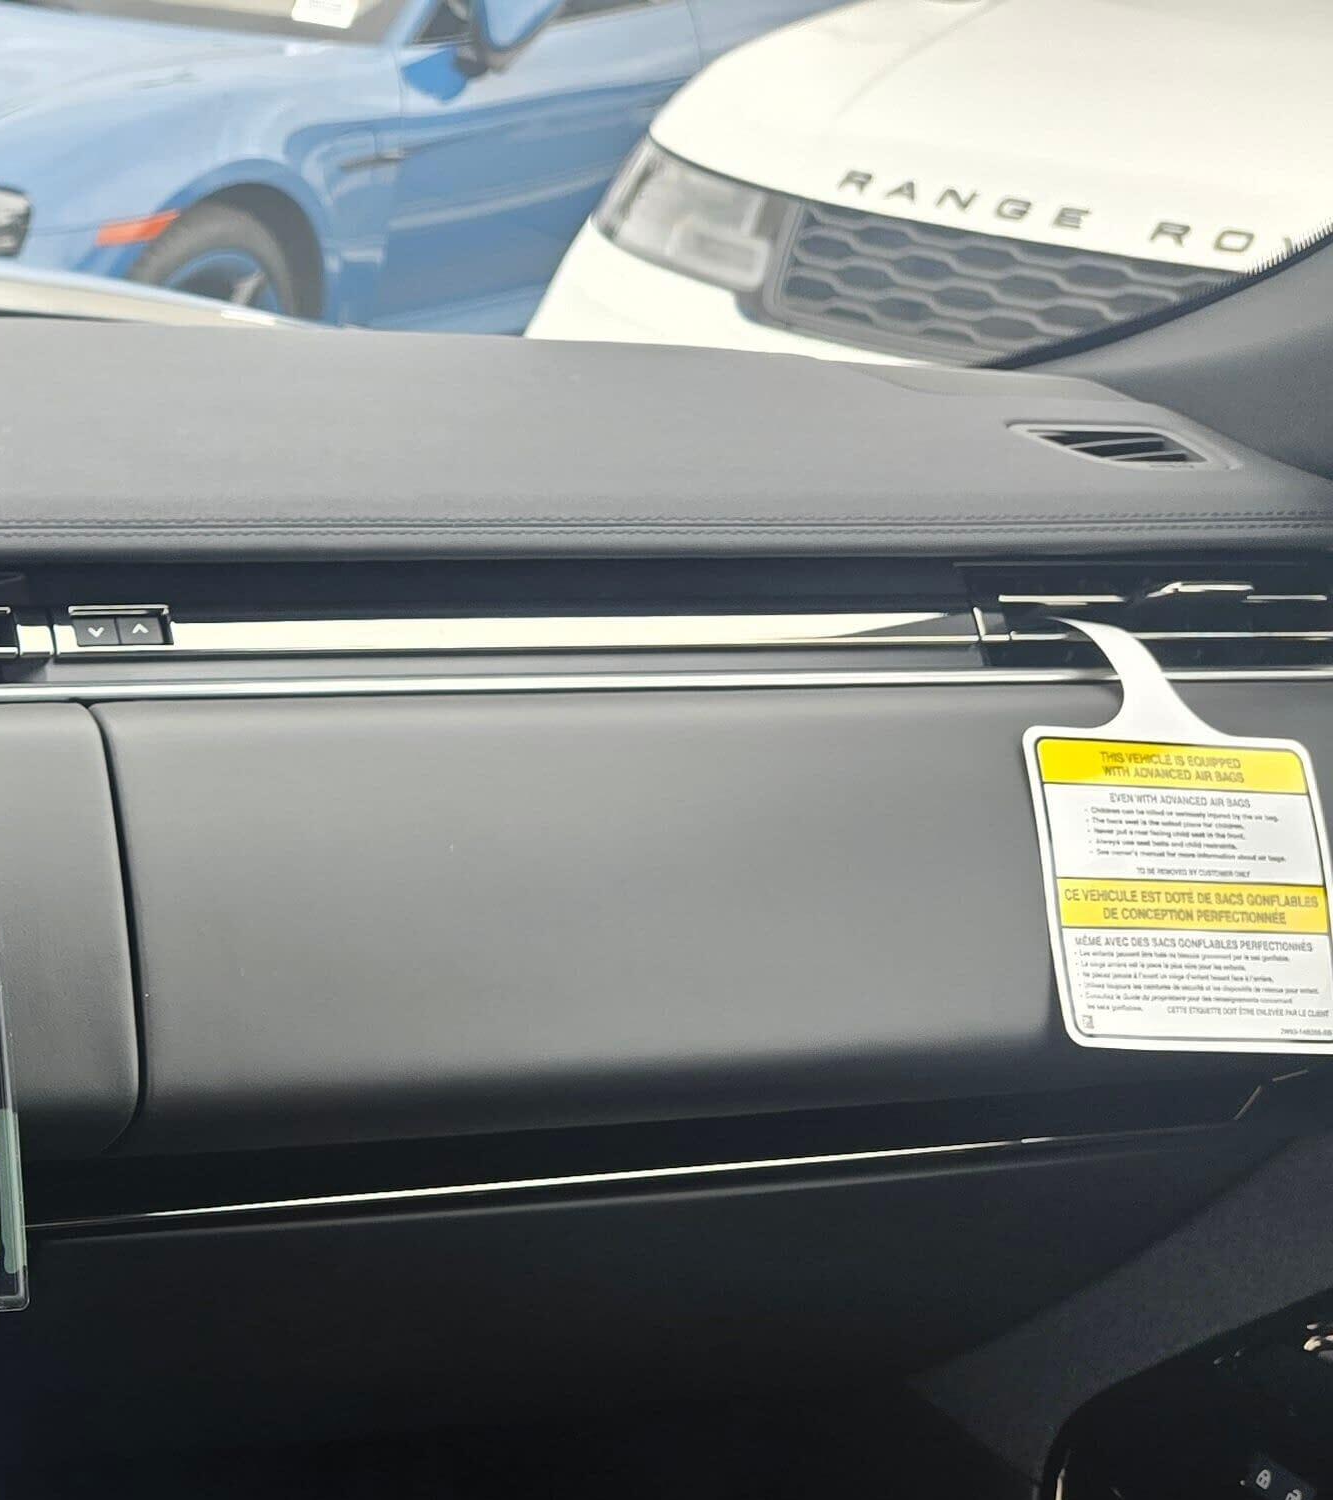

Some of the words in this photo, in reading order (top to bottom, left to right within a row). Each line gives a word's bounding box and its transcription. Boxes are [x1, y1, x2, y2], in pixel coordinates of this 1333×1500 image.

[838, 169, 1090, 230] RANGE
[1148, 221, 1293, 258] RO
[1100, 751, 1125, 764] THIS
[1125, 753, 1173, 766] VEHICLE
[1175, 755, 1184, 767] IS
[1188, 756, 1241, 769] EQUIPPED
[1102, 765, 1130, 777] WITH
[1134, 767, 1192, 781] ADVANCED
[1195, 770, 1213, 782] AIR
[1215, 771, 1245, 784] BAGS
[1160, 794, 1208, 807] ADVANCED
[1064, 888, 1081, 902] CE
[1141, 890, 1162, 904] EST
[1196, 892, 1213, 905] DE
[1215, 892, 1244, 906] SACS
[1246, 893, 1319, 908] GONFLABLES
[1102, 907, 1119, 920] DE
[1121, 907, 1194, 922] CONCEPTION
